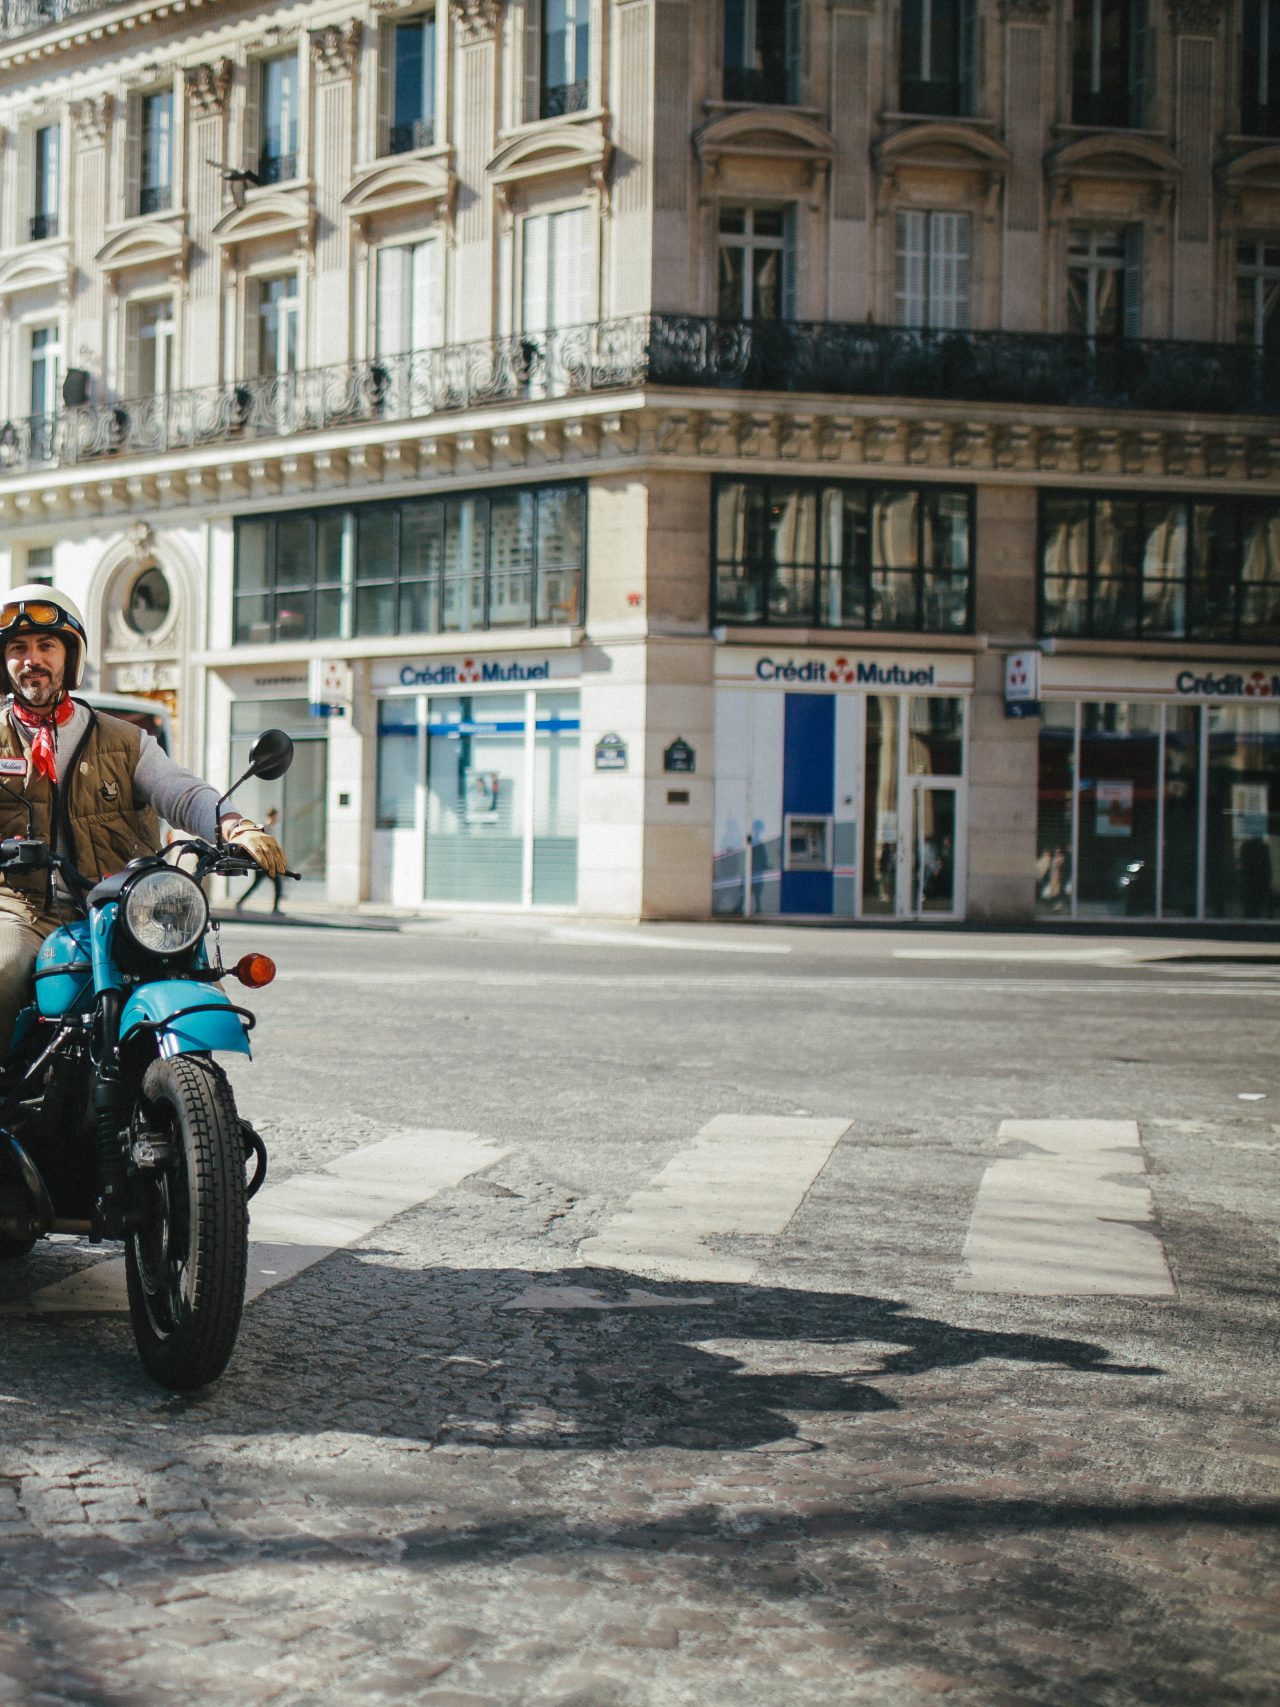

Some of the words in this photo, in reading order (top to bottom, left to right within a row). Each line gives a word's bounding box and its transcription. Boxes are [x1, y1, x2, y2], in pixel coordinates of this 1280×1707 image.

[400, 665, 458, 686] Crédit
[481, 660, 549, 682] Mutuel
[755, 658, 826, 682] Crédit
[856, 662, 934, 686] Mutuel
[1177, 671, 1243, 695] Crédit
